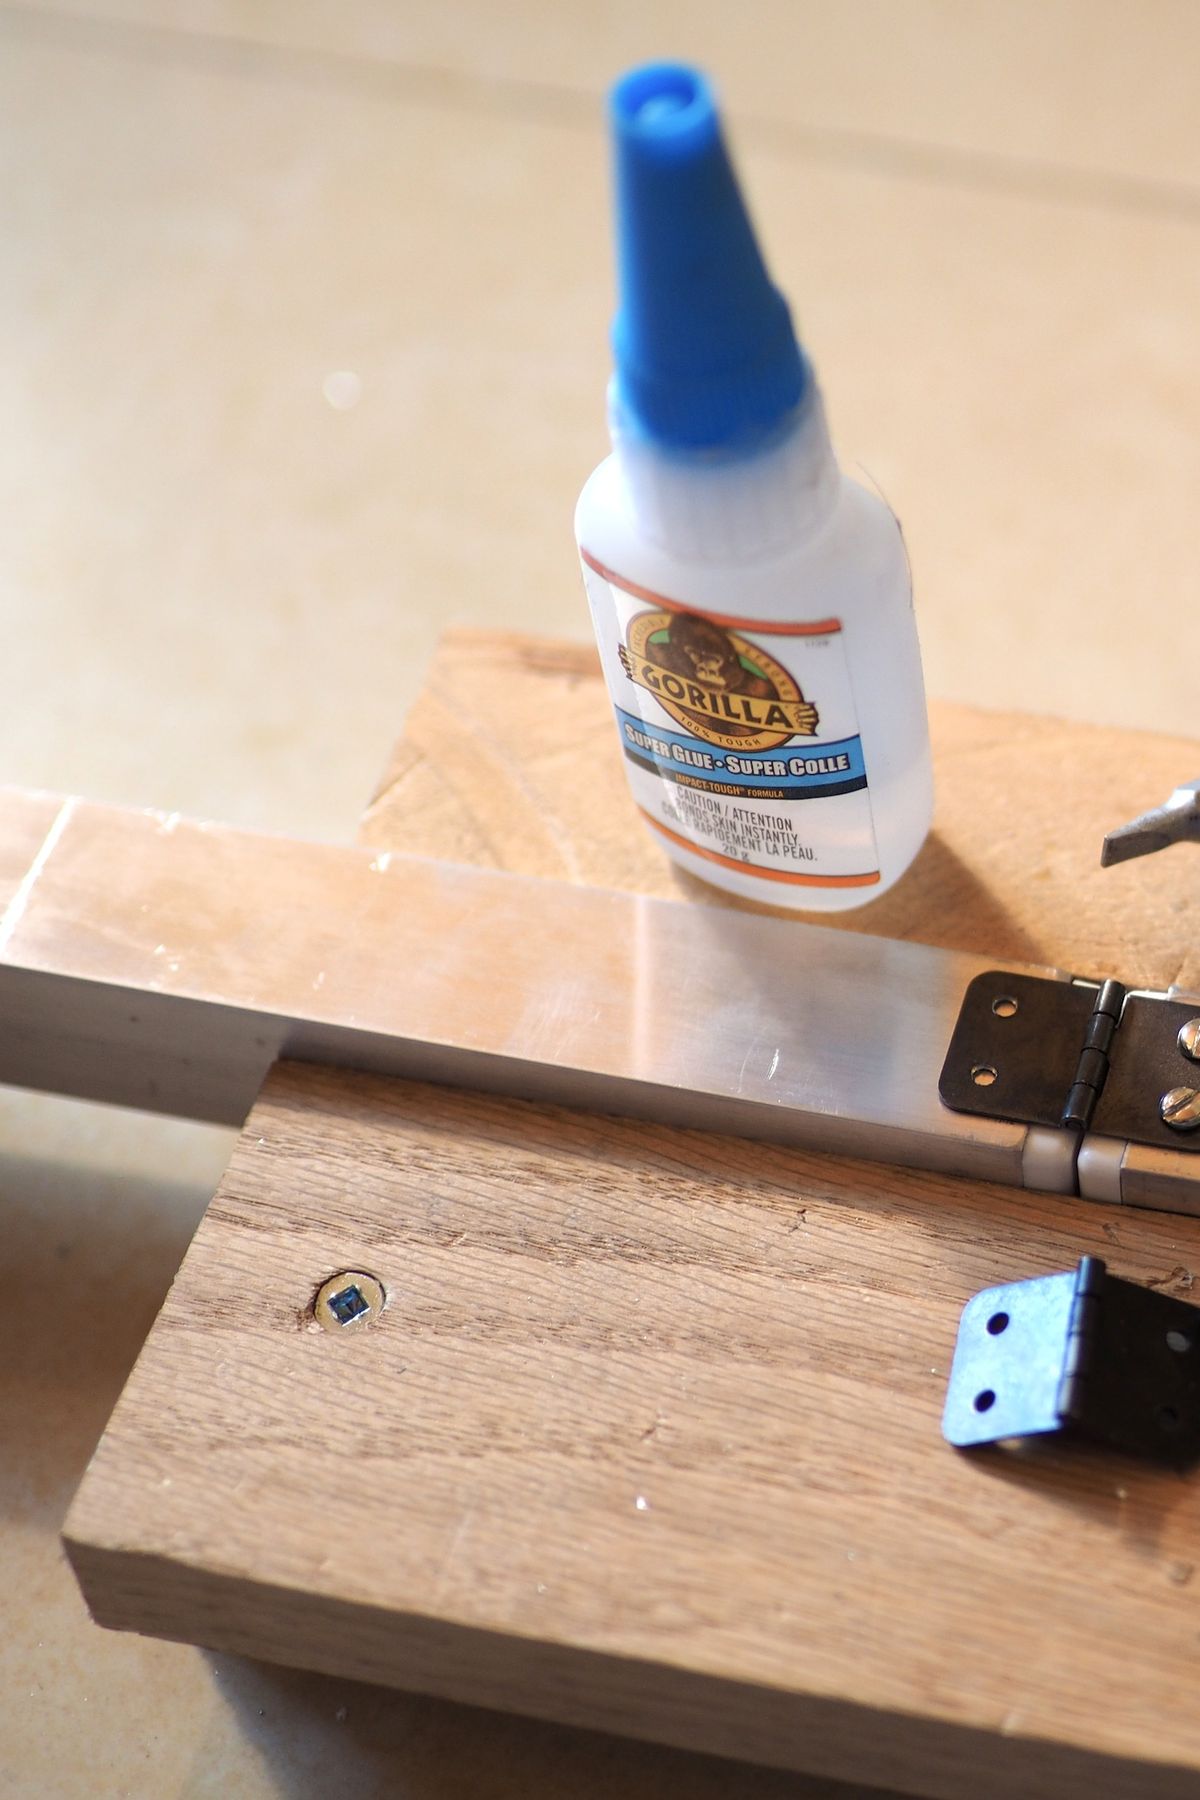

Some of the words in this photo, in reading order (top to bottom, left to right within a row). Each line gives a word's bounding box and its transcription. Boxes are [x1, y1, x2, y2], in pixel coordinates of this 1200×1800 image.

[641, 665, 793, 729] GORILLA
[624, 721, 671, 760] SUPER
[671, 743, 714, 770] GLUE
[725, 755, 788, 776] SUPER
[789, 753, 850, 776] COLLE
[681, 716, 710, 738] 100%
[718, 736, 761, 747] TOUGH
[677, 785, 721, 814] CAUTION
[732, 807, 793, 831] ATTENTION
[747, 789, 784, 798] FORMULA
[694, 818, 761, 852] RAPIDEMENT
[765, 841, 780, 856] LA
[783, 845, 818, 861] PEAU.
[712, 814, 737, 833] SKIN
